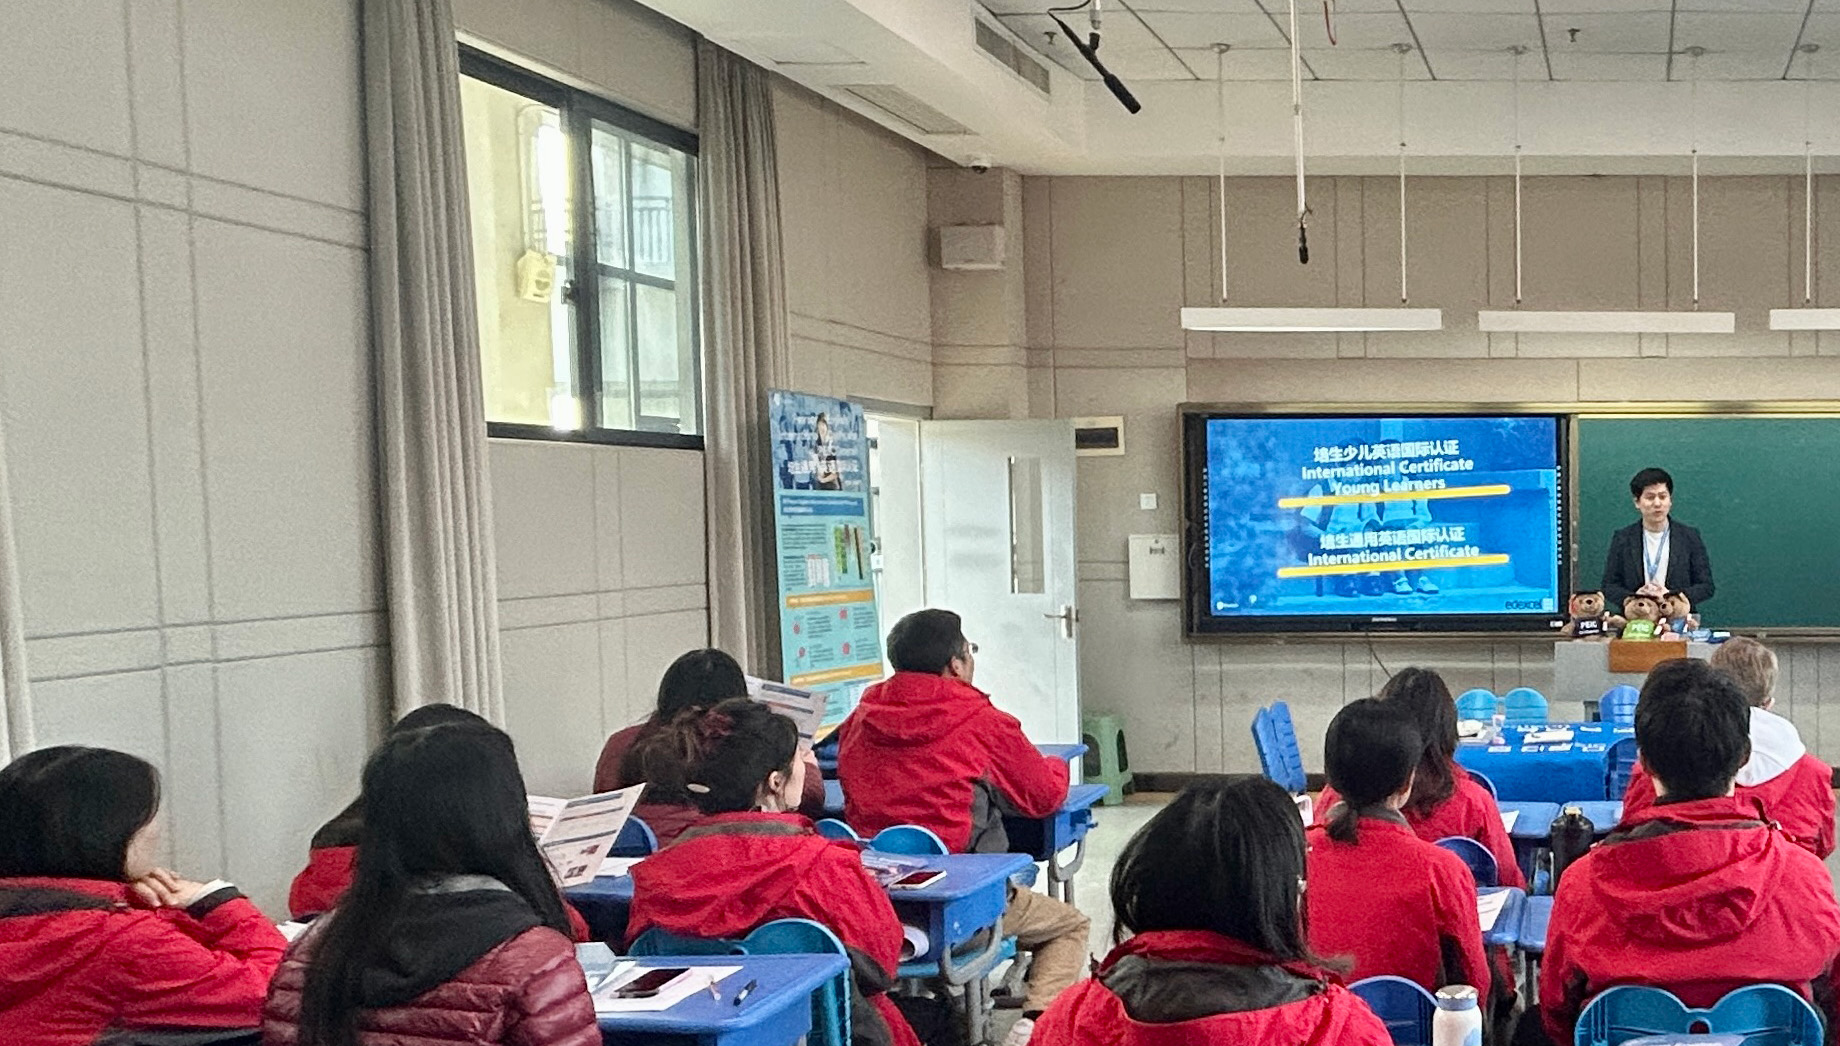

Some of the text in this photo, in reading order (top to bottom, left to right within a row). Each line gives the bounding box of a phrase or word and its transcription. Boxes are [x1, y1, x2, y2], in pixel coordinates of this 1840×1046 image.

[1313, 440, 1460, 463] 培生少儿英语国际认证
[1302, 458, 1474, 480] International Certificate
[1333, 478, 1446, 497] Young Learners
[1320, 526, 1466, 549] 培生通用英语国际认证
[1308, 544, 1480, 567] International Certificate
